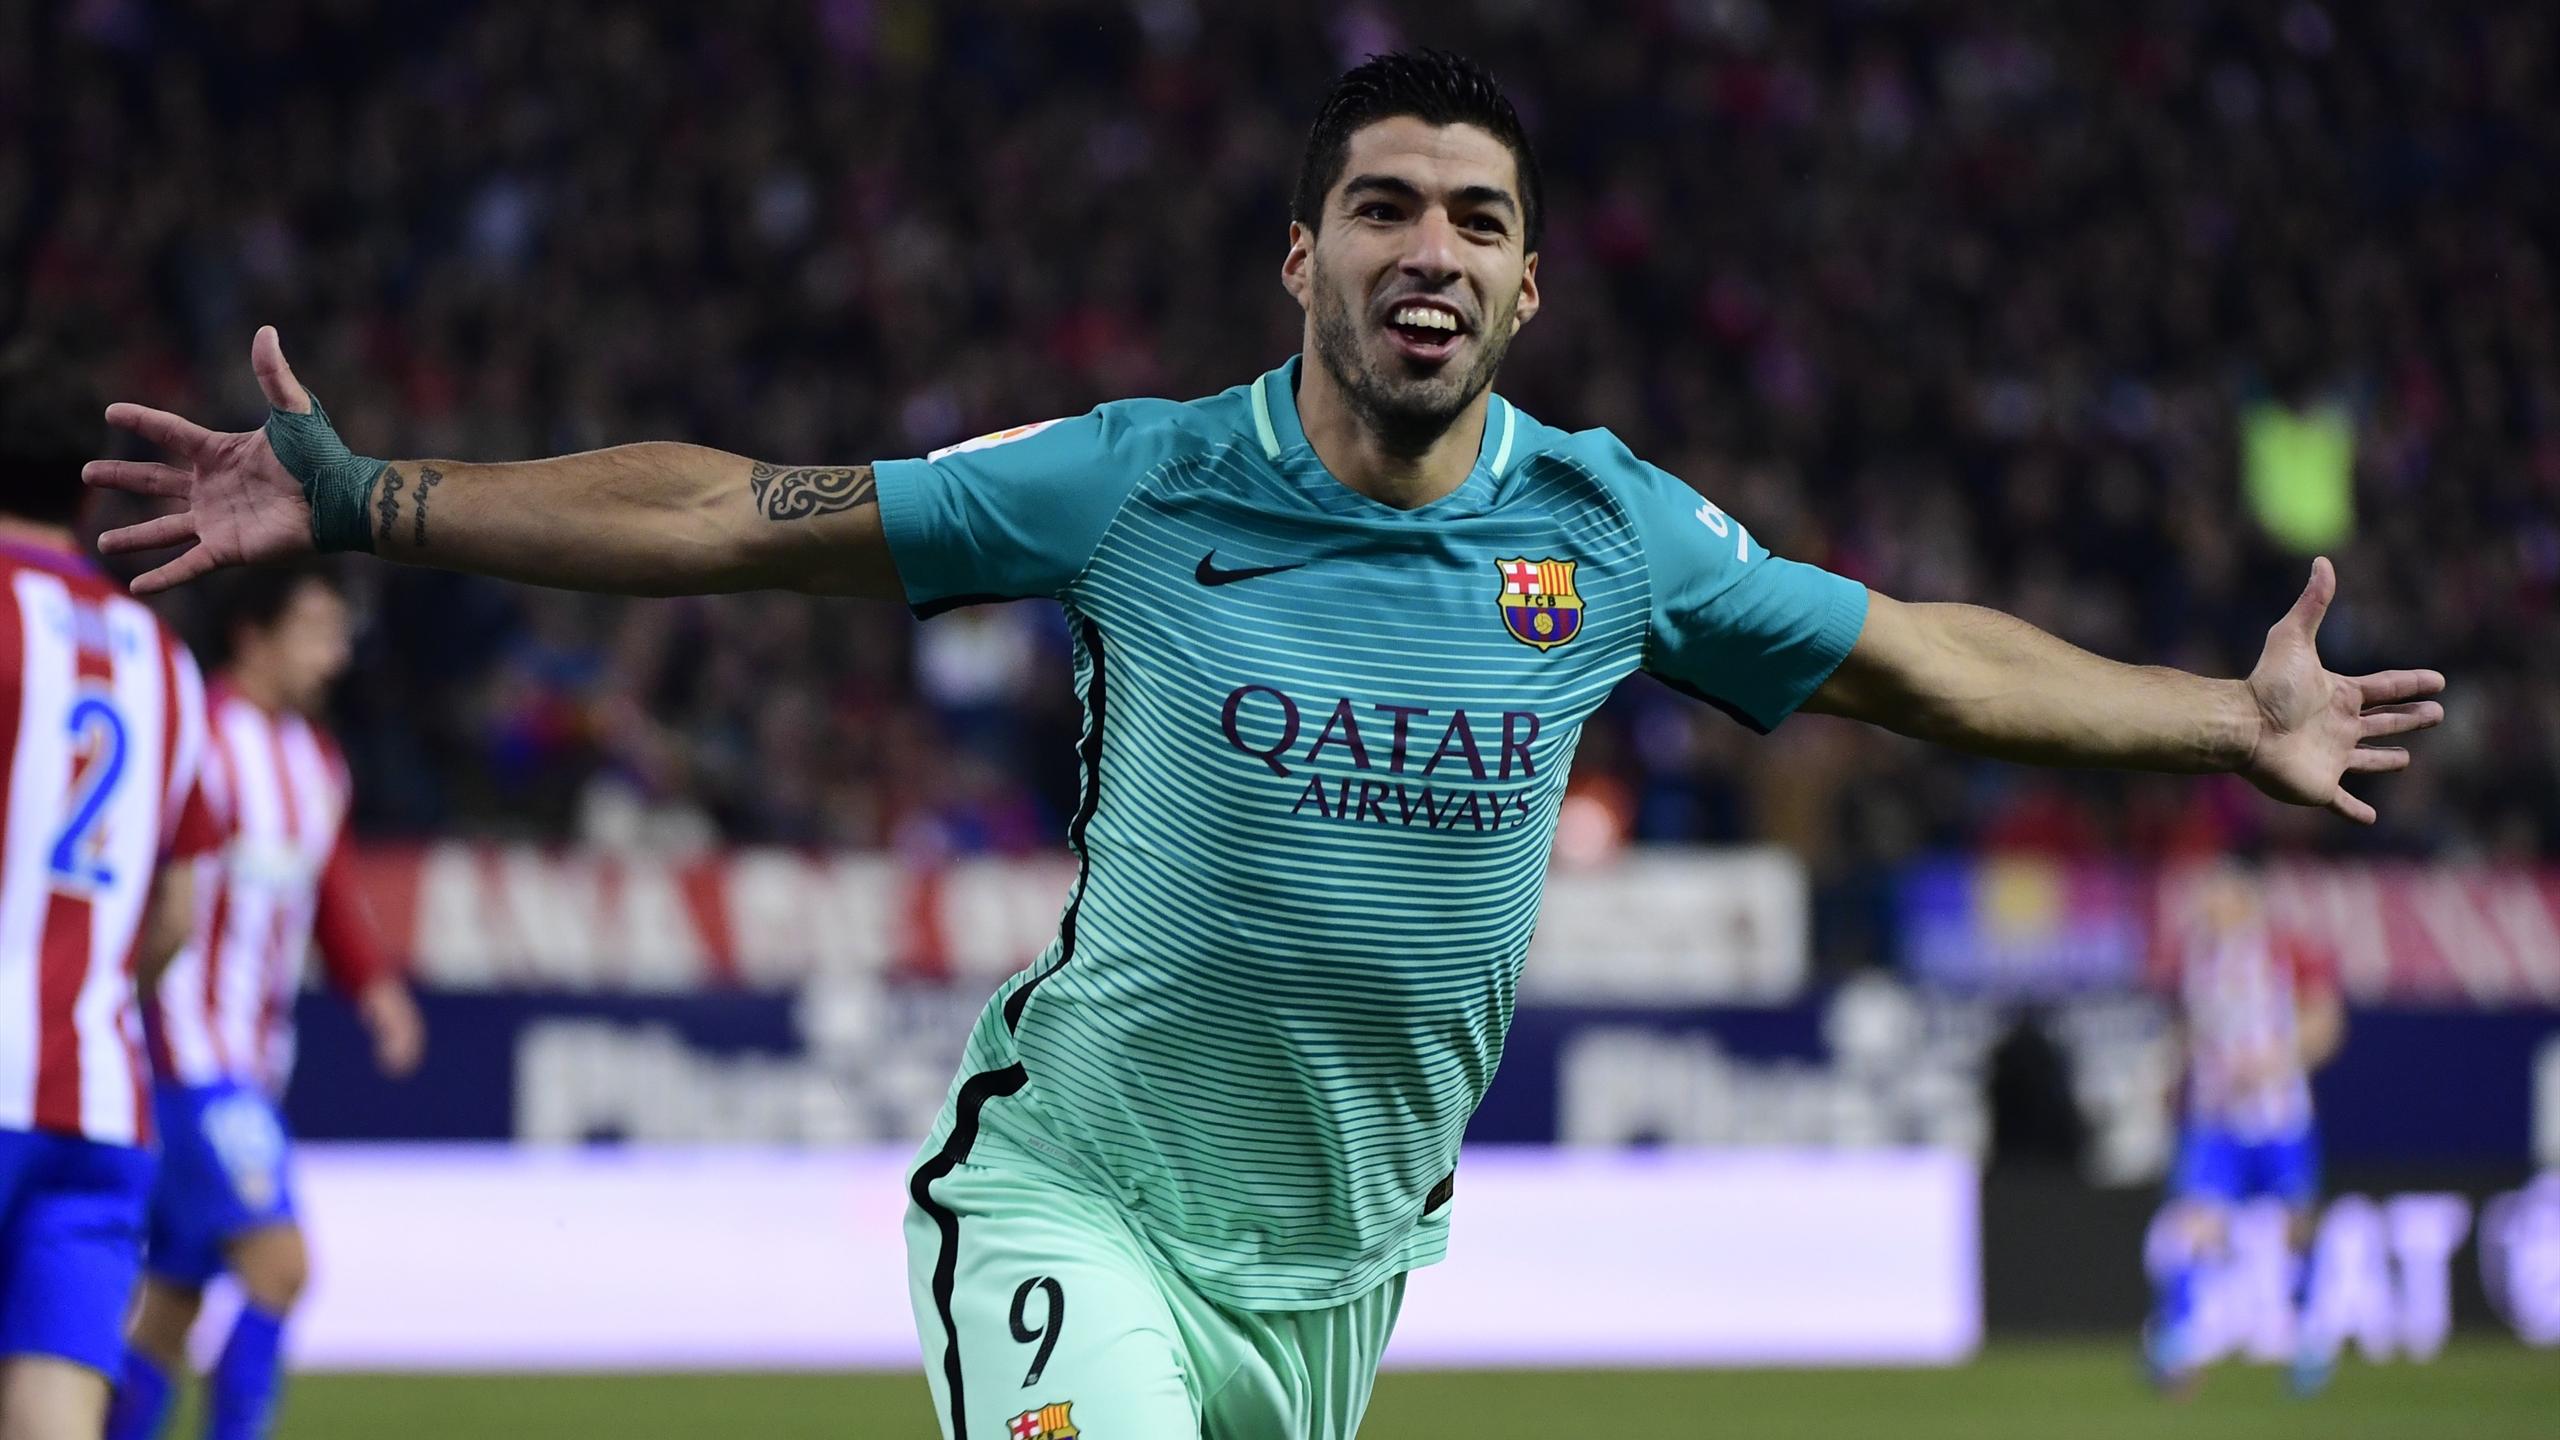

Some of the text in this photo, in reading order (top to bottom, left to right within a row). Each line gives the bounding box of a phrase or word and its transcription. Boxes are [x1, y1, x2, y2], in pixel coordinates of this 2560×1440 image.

[1524, 595, 1556, 607] FCB
[1221, 684, 1541, 781] QATAR
[50, 697, 127, 885] 2
[1292, 773, 1533, 832] AIRWAYS
[1008, 1275, 1065, 1389] 9
